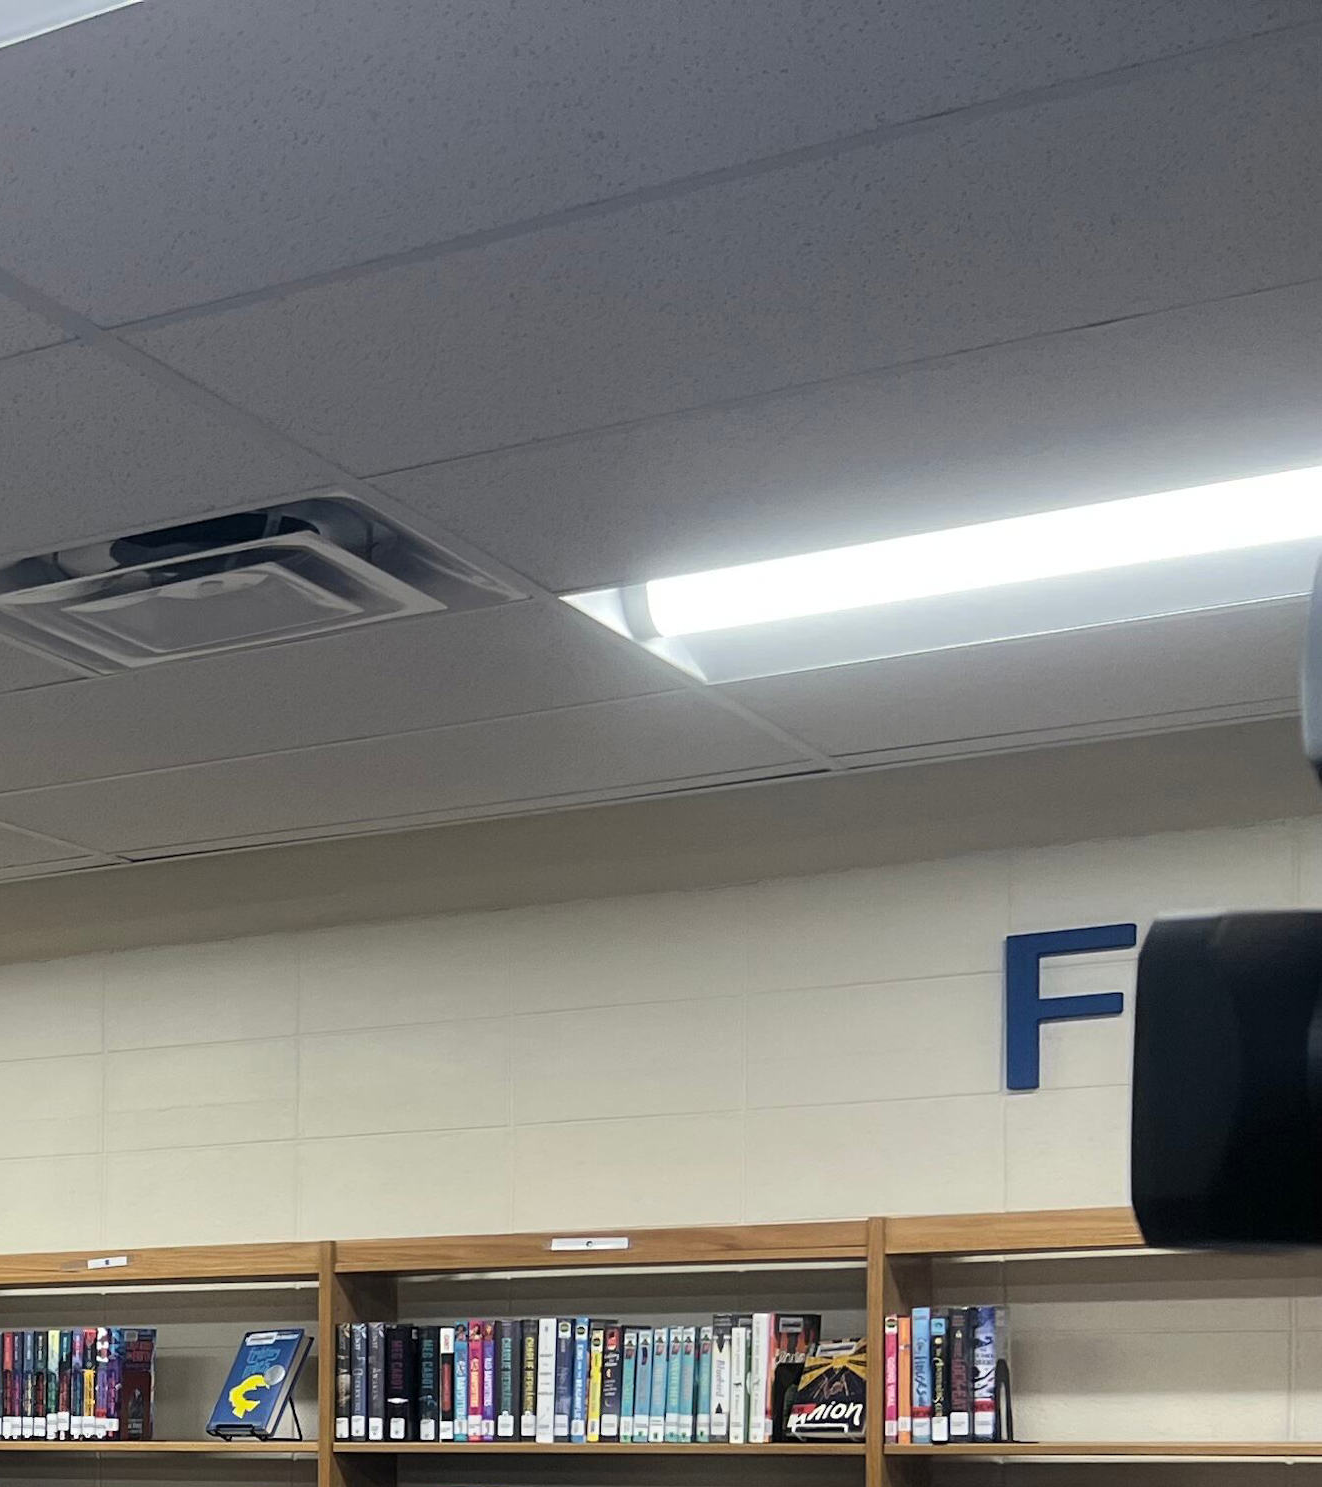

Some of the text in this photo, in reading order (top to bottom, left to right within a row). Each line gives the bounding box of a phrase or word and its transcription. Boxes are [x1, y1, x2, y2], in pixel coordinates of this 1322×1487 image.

[1006, 923, 1137, 1090] F
[422, 1339, 433, 1390] MEG CABOT
